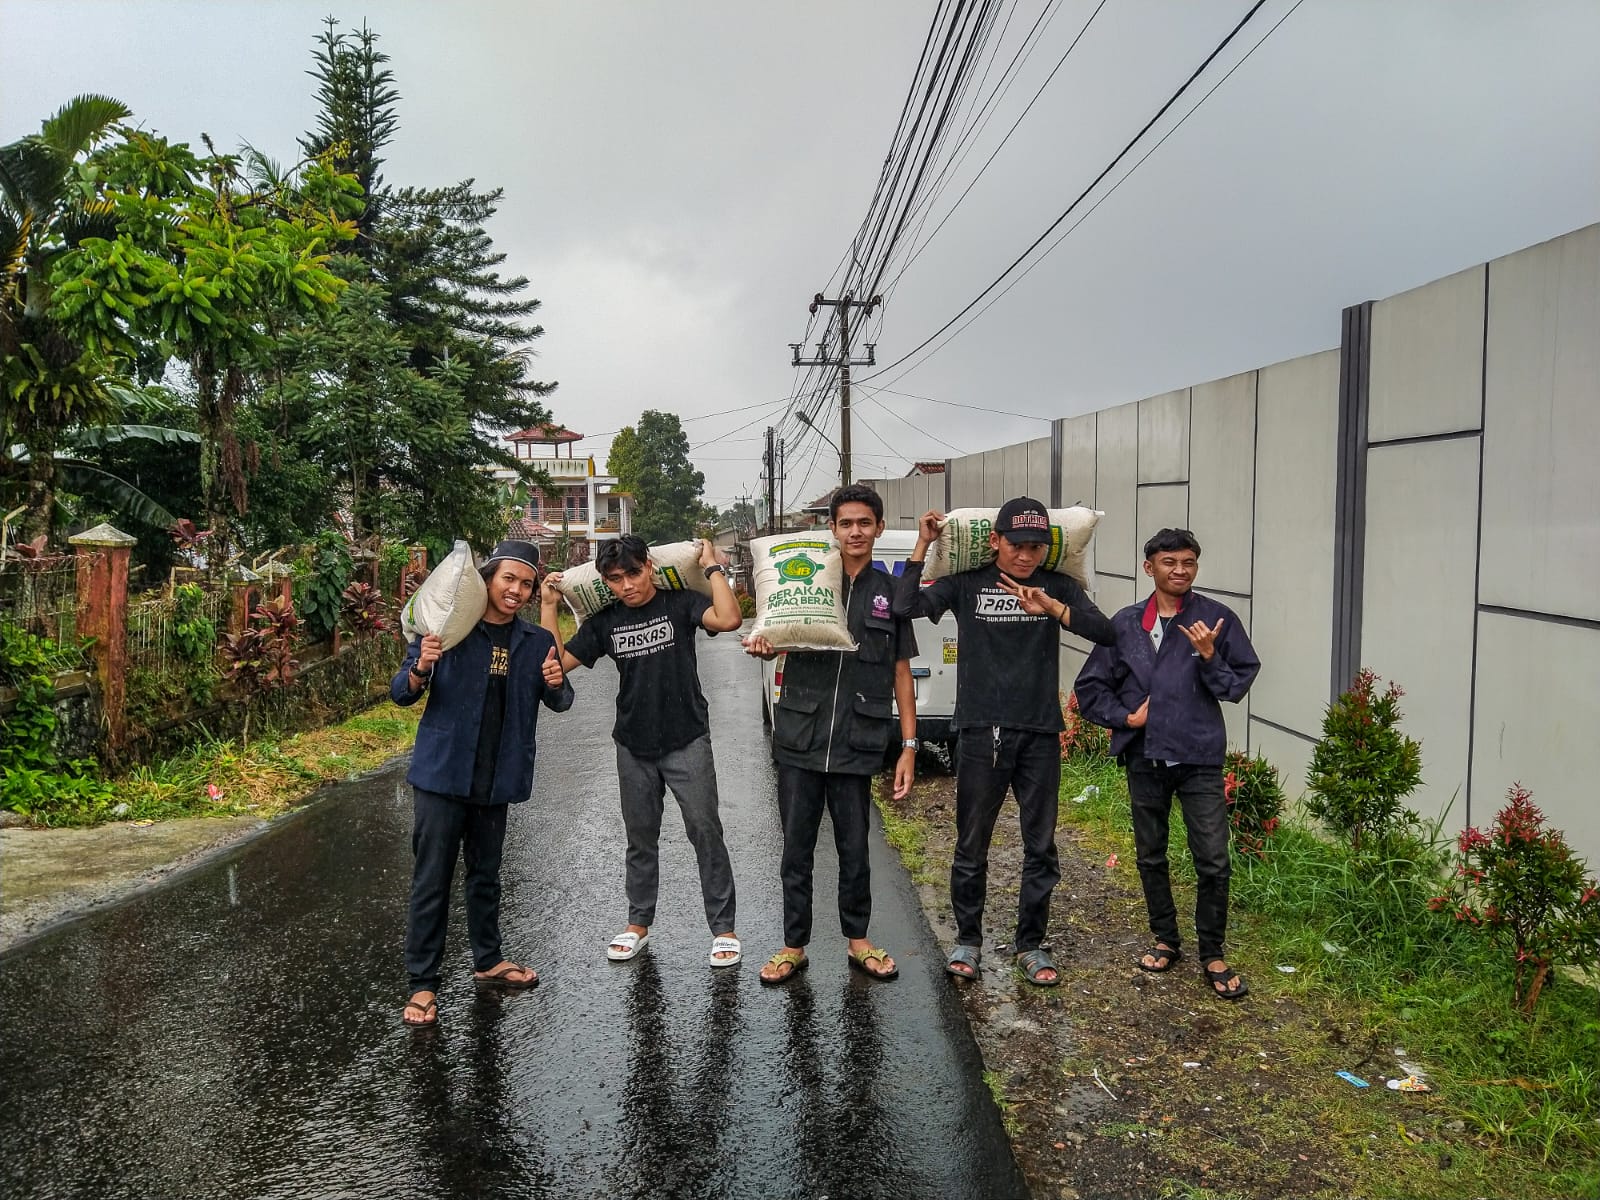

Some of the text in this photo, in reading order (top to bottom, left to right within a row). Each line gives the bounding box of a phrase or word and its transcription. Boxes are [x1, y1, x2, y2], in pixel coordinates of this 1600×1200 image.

[767, 596, 835, 610] INFAQ BERAS
[768, 586, 834, 603] GERAKAN
[618, 626, 667, 649] PASKAS
